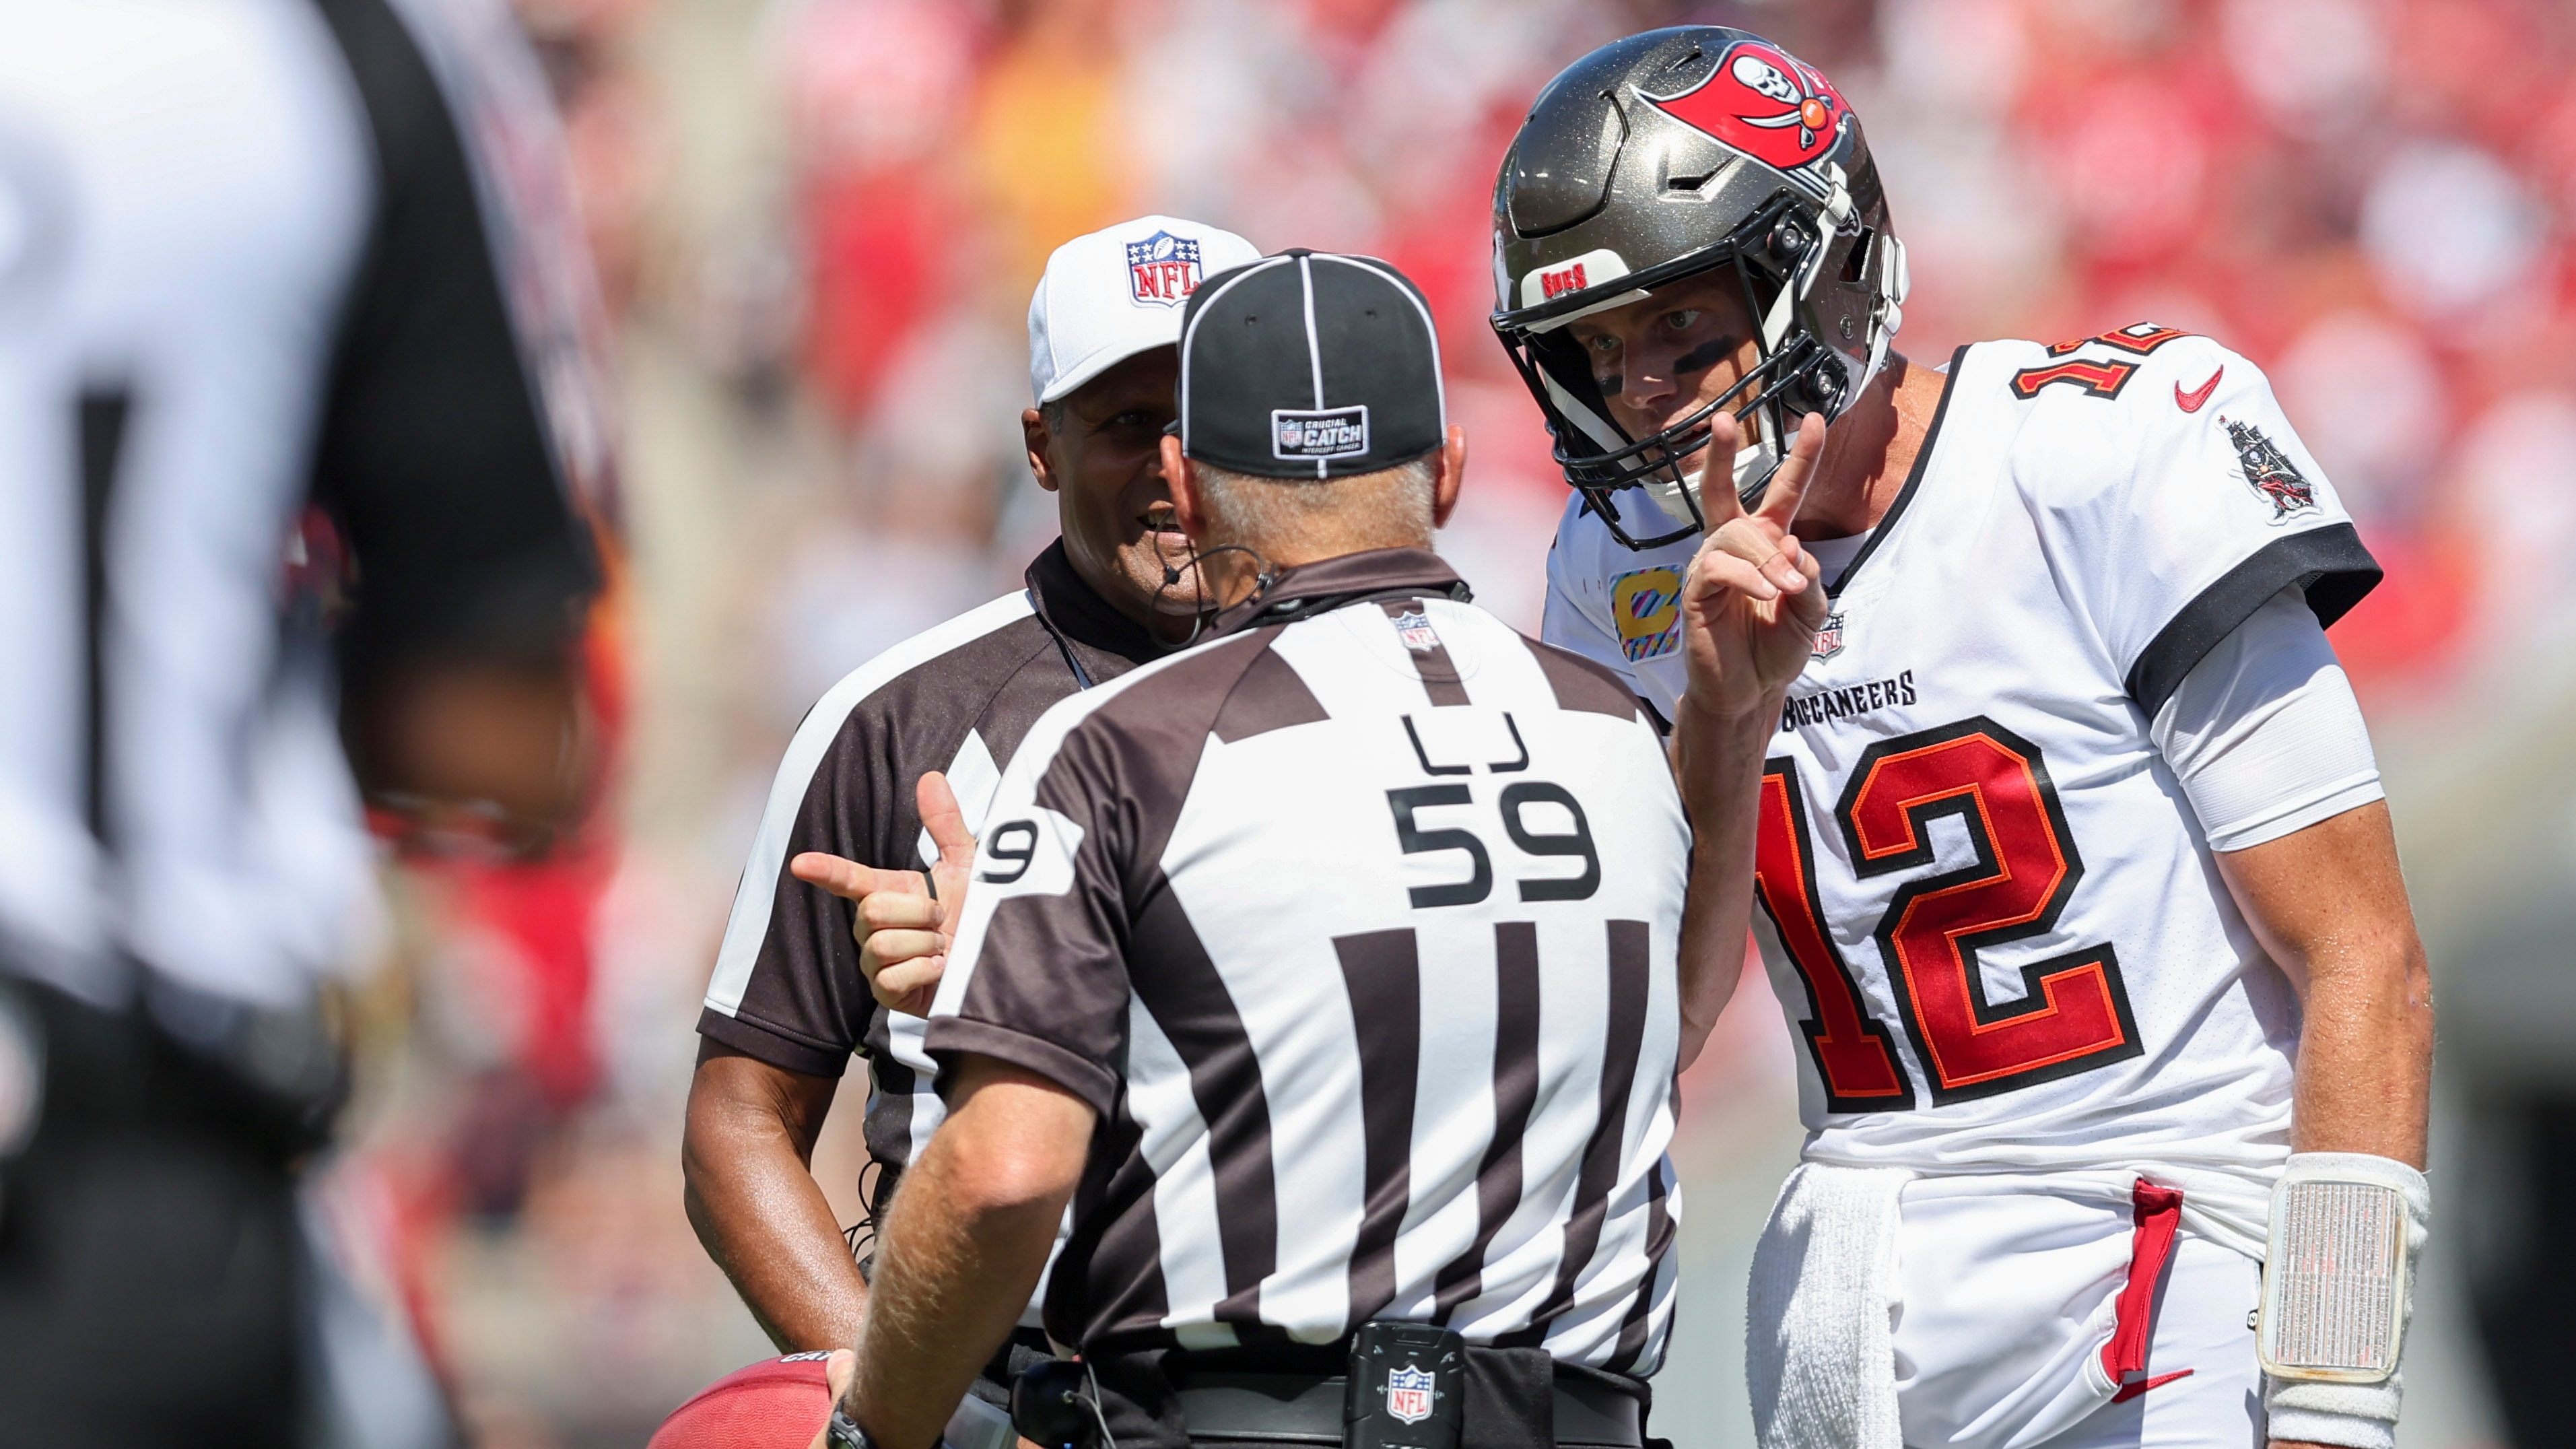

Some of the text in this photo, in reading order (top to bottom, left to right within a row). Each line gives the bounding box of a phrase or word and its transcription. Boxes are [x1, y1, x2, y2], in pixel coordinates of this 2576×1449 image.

[1133, 261, 1200, 300] NFL
[1303, 424, 1362, 446] CATCH
[1305, 417, 1347, 430] CRUCIAL
[1282, 431, 1303, 443] NFL
[1301, 446, 1333, 454] INTERCEPT
[1615, 570, 1681, 639] C
[1401, 629, 1439, 644] NFL
[1782, 668, 1918, 732] BUCCANEERS
[1400, 711, 1530, 776] LJ
[1384, 781, 1602, 910] 59
[1753, 714, 2146, 1114] 12
[780, 1350, 834, 1363] CAT
[1393, 1390, 1426, 1415] NFL
